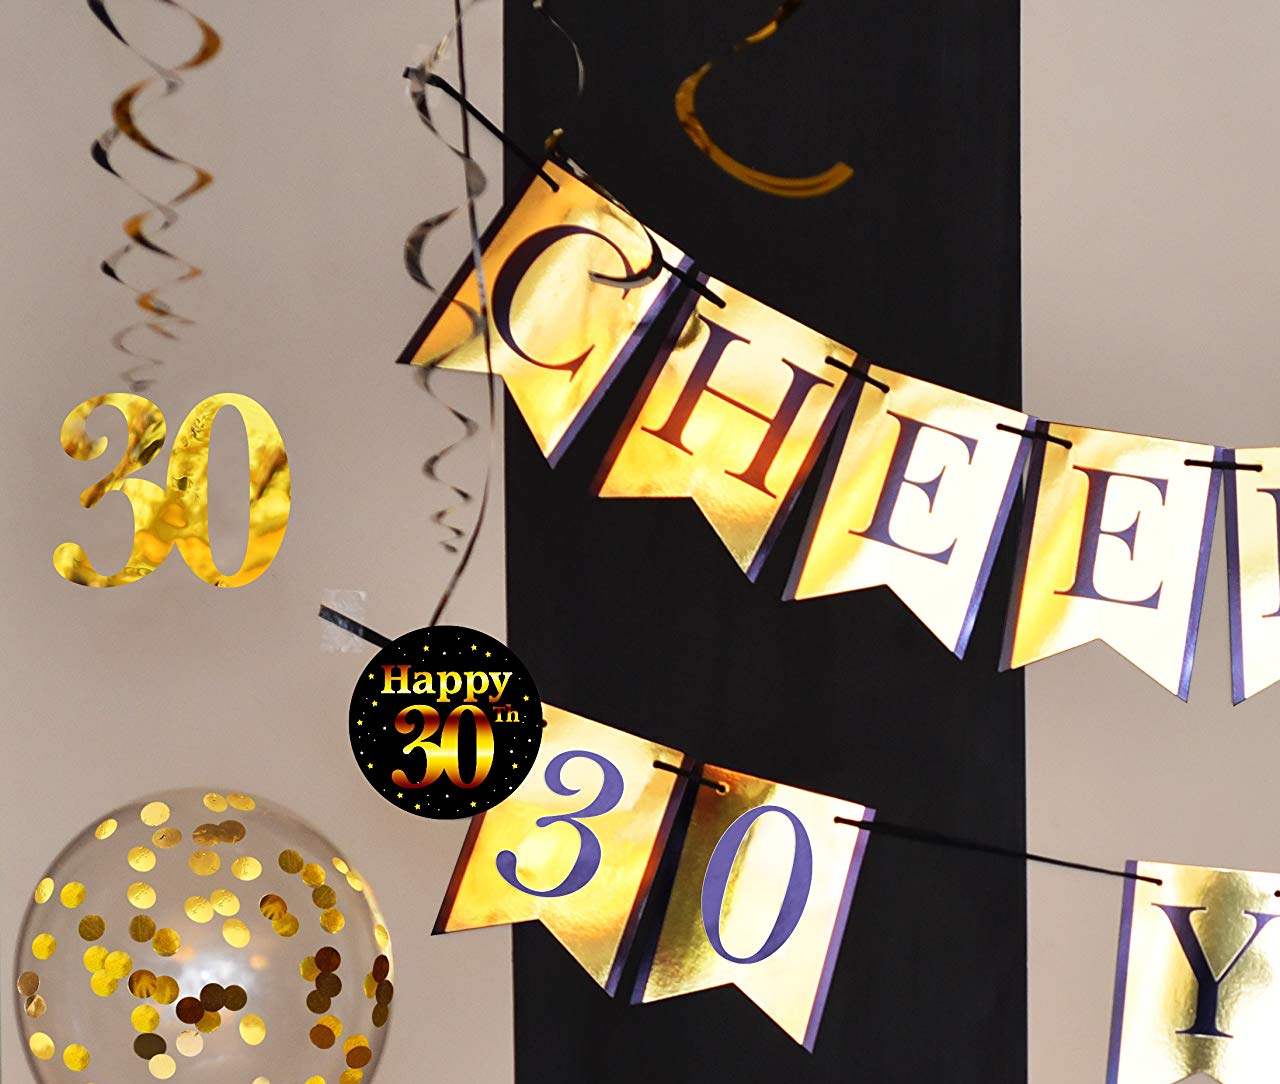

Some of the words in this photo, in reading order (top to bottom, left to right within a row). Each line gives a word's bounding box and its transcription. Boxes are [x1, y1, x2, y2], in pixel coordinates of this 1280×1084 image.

[52, 392, 291, 588] 30
[380, 665, 513, 703] Happy
[496, 750, 813, 965] 30
